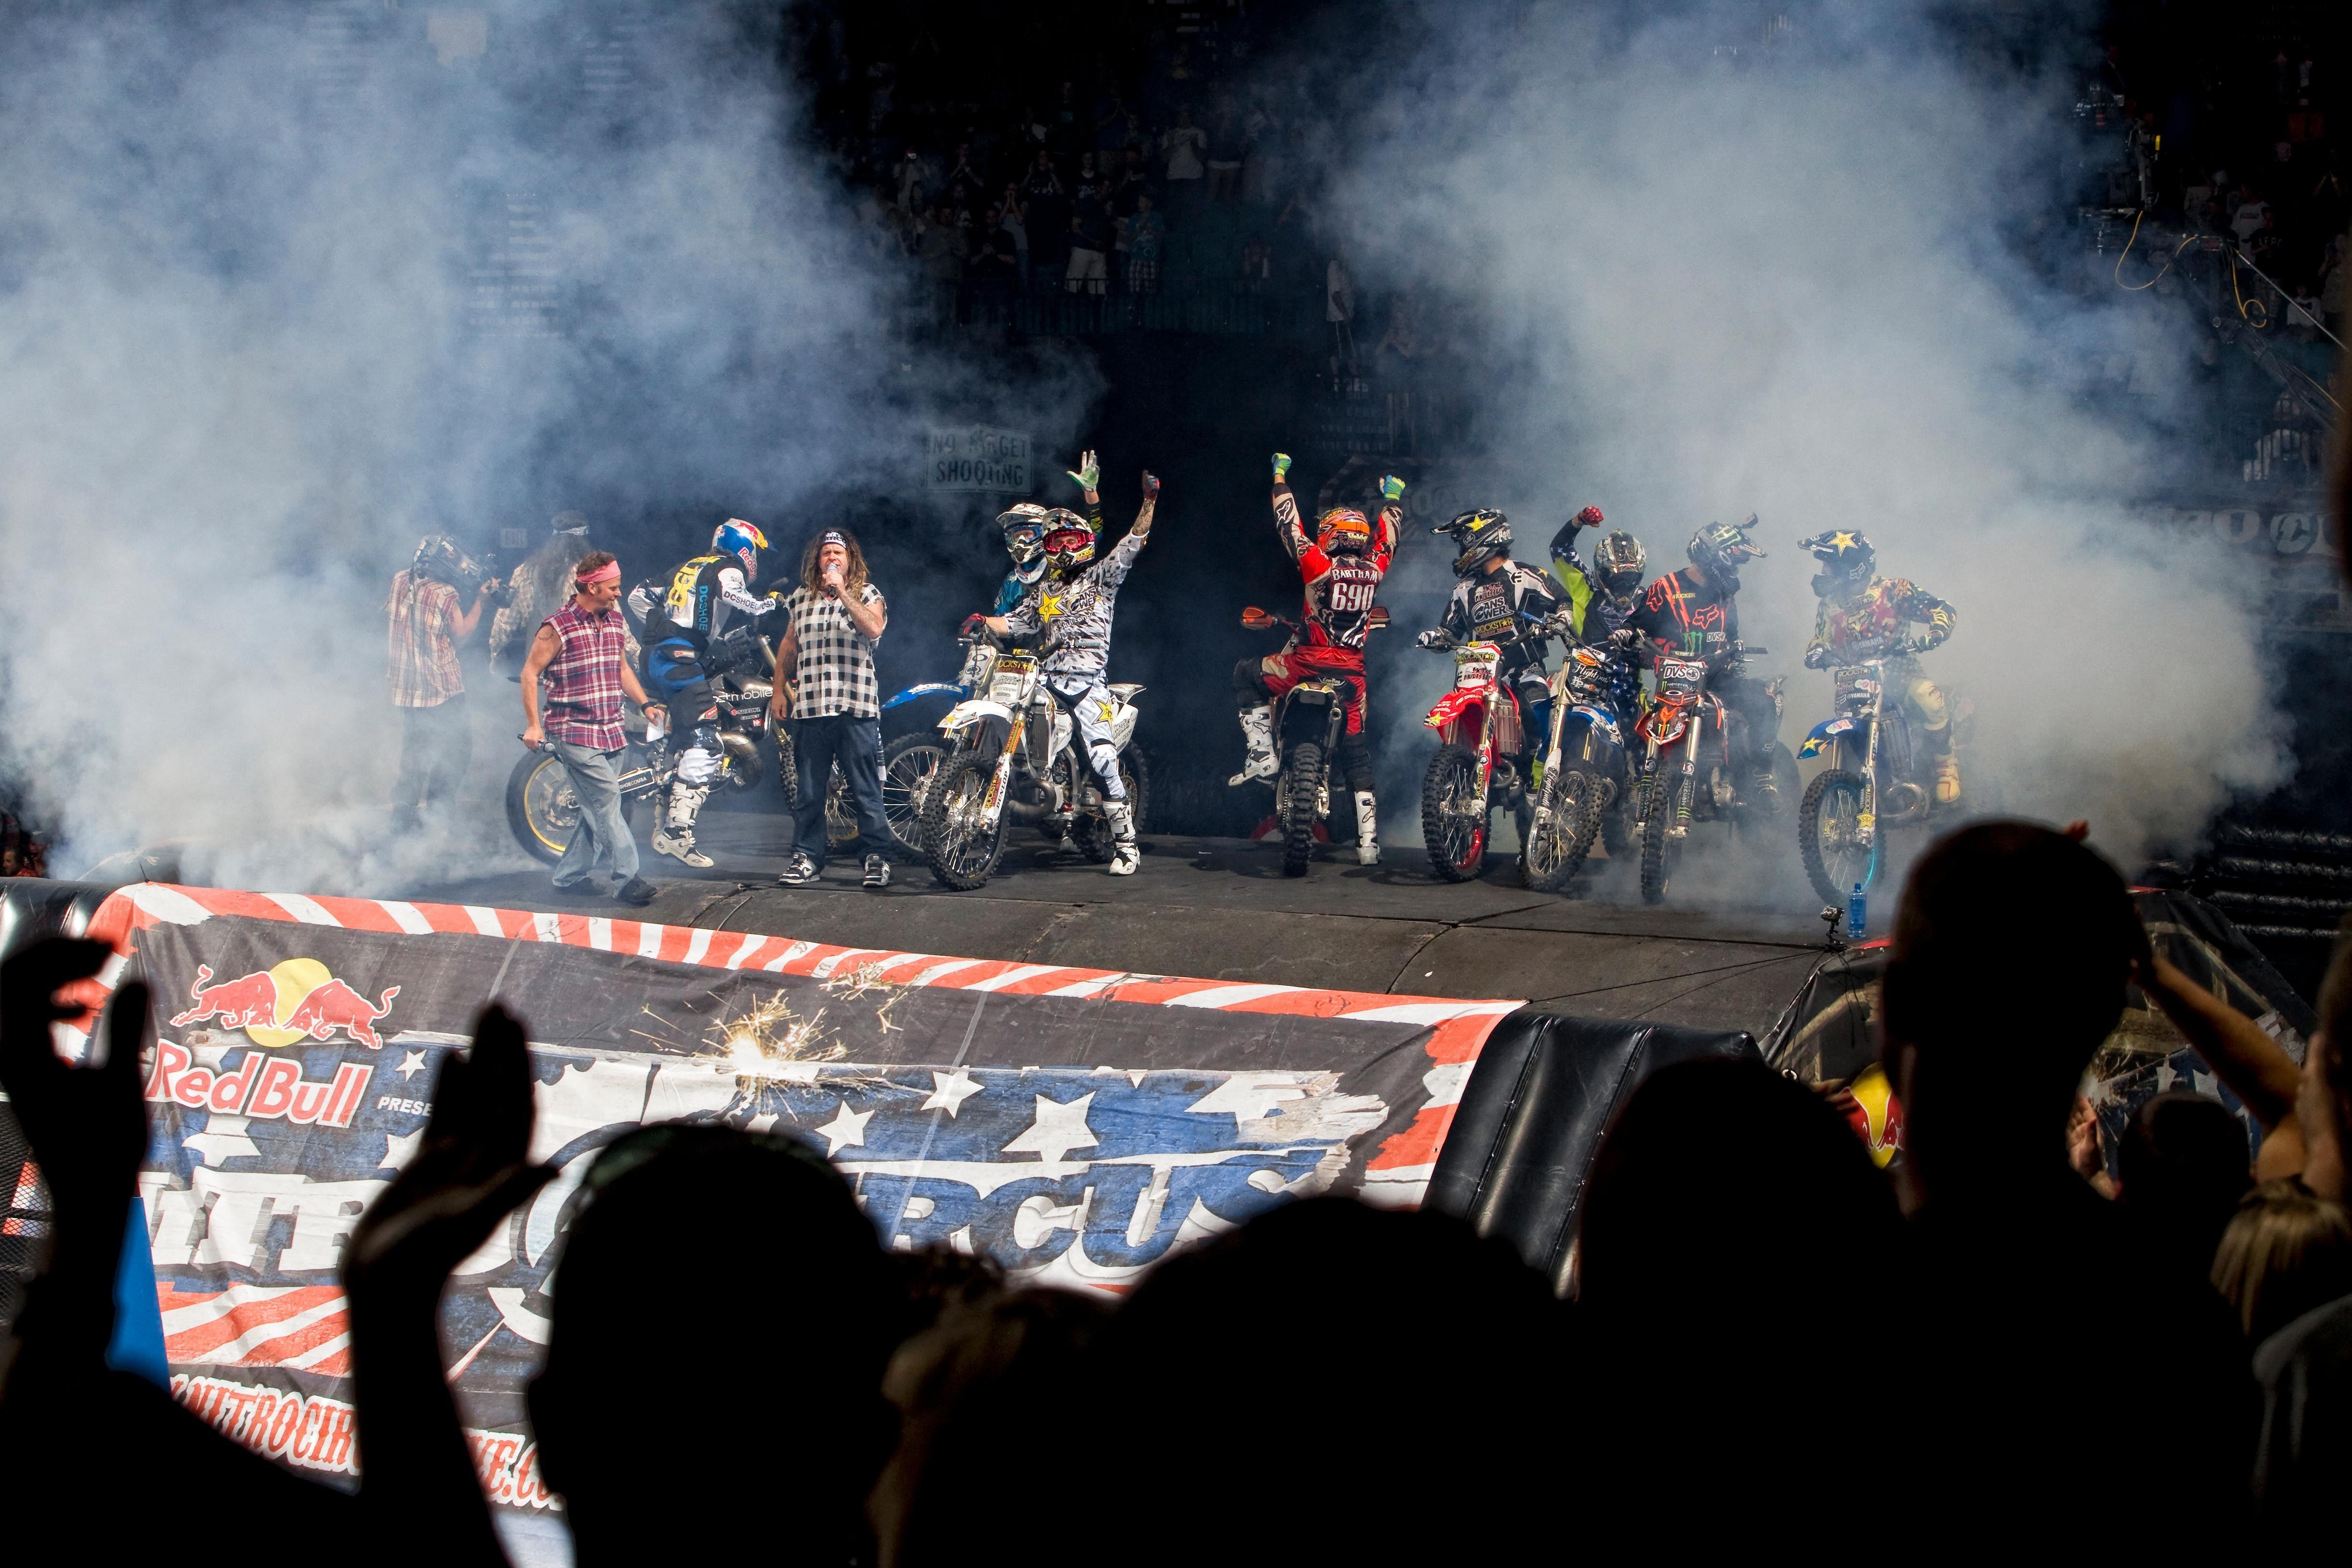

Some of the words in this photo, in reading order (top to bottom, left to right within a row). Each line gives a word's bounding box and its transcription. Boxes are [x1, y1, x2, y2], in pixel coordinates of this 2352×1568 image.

[1331, 582, 1374, 611] 690
[1059, 613, 1092, 630] Skullcand
[996, 770, 1008, 808] DUNLOP
